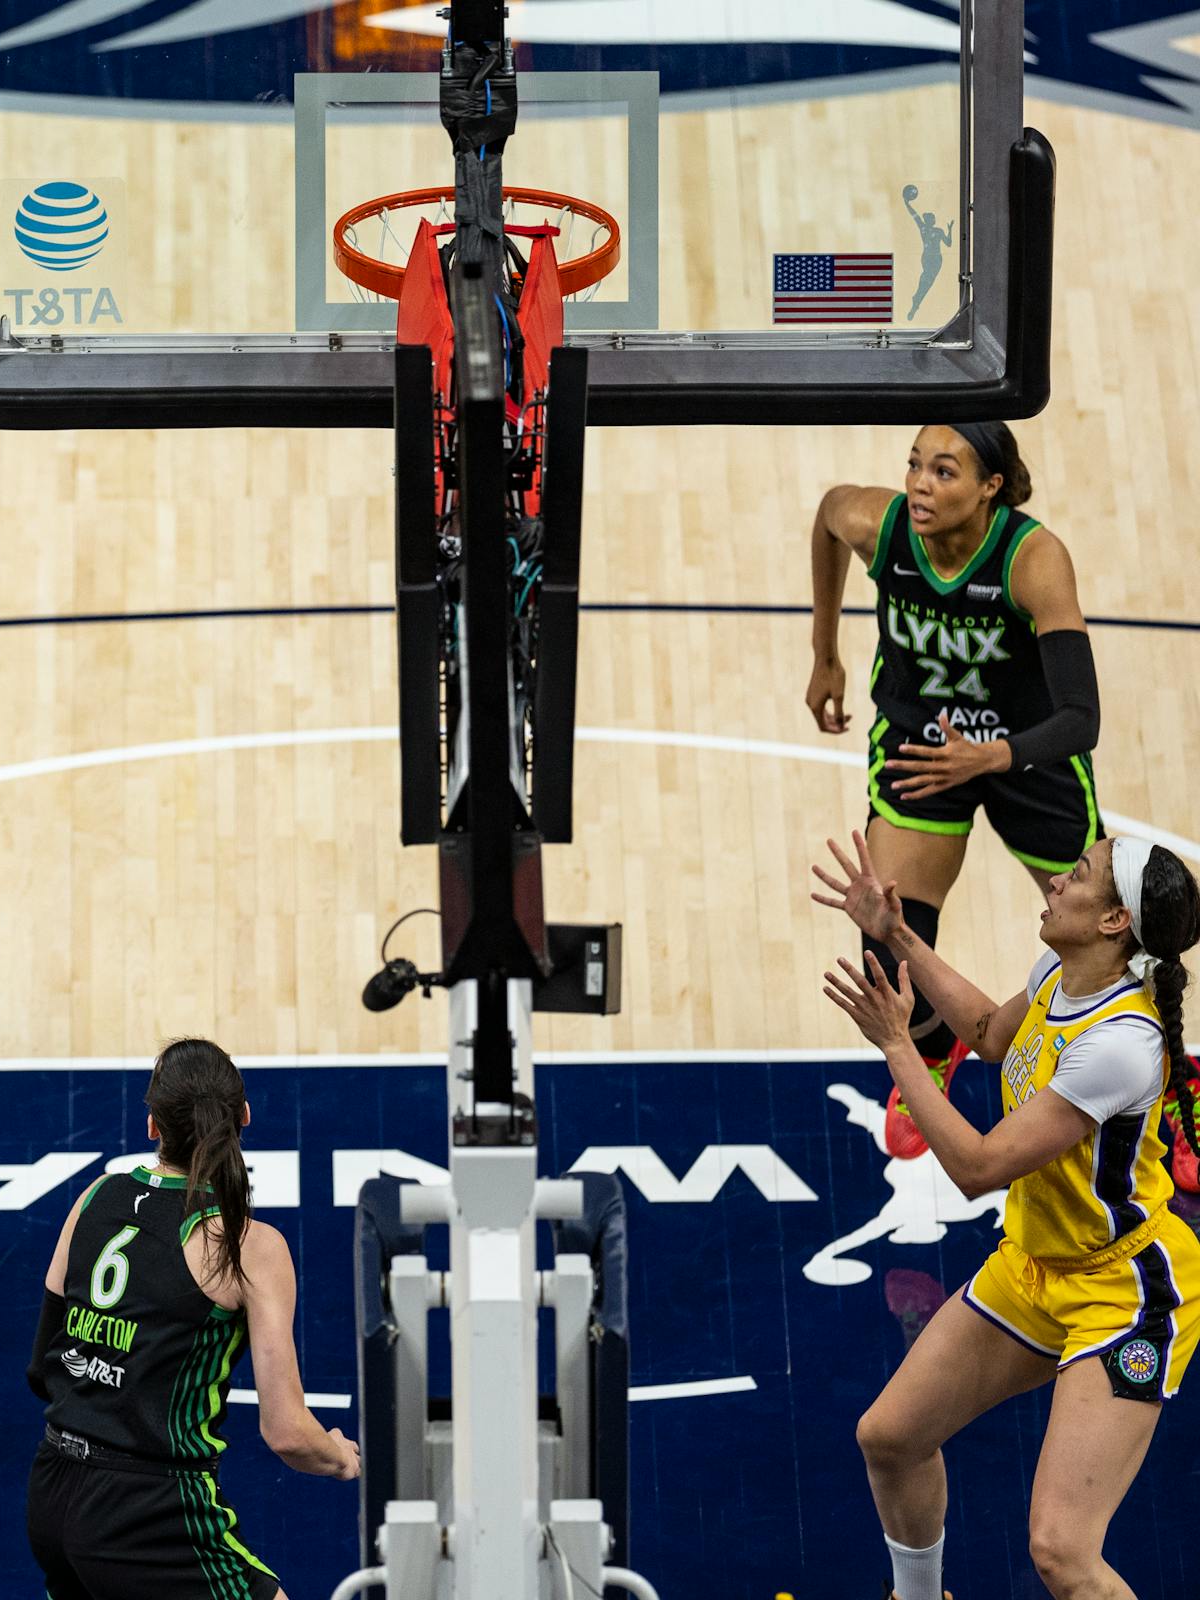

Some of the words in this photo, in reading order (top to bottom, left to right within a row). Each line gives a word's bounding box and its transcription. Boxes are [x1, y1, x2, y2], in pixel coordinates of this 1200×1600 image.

[889, 593, 1005, 627] MINNESOTA
[888, 603, 1012, 664] LYNX
[916, 658, 991, 702] 24
[923, 722, 1009, 744] CNIC
[935, 706, 999, 726] AYO
[90, 1225, 140, 1309] 6
[66, 1306, 138, 1352] CARLETON
[86, 1356, 125, 1388] AT&T
